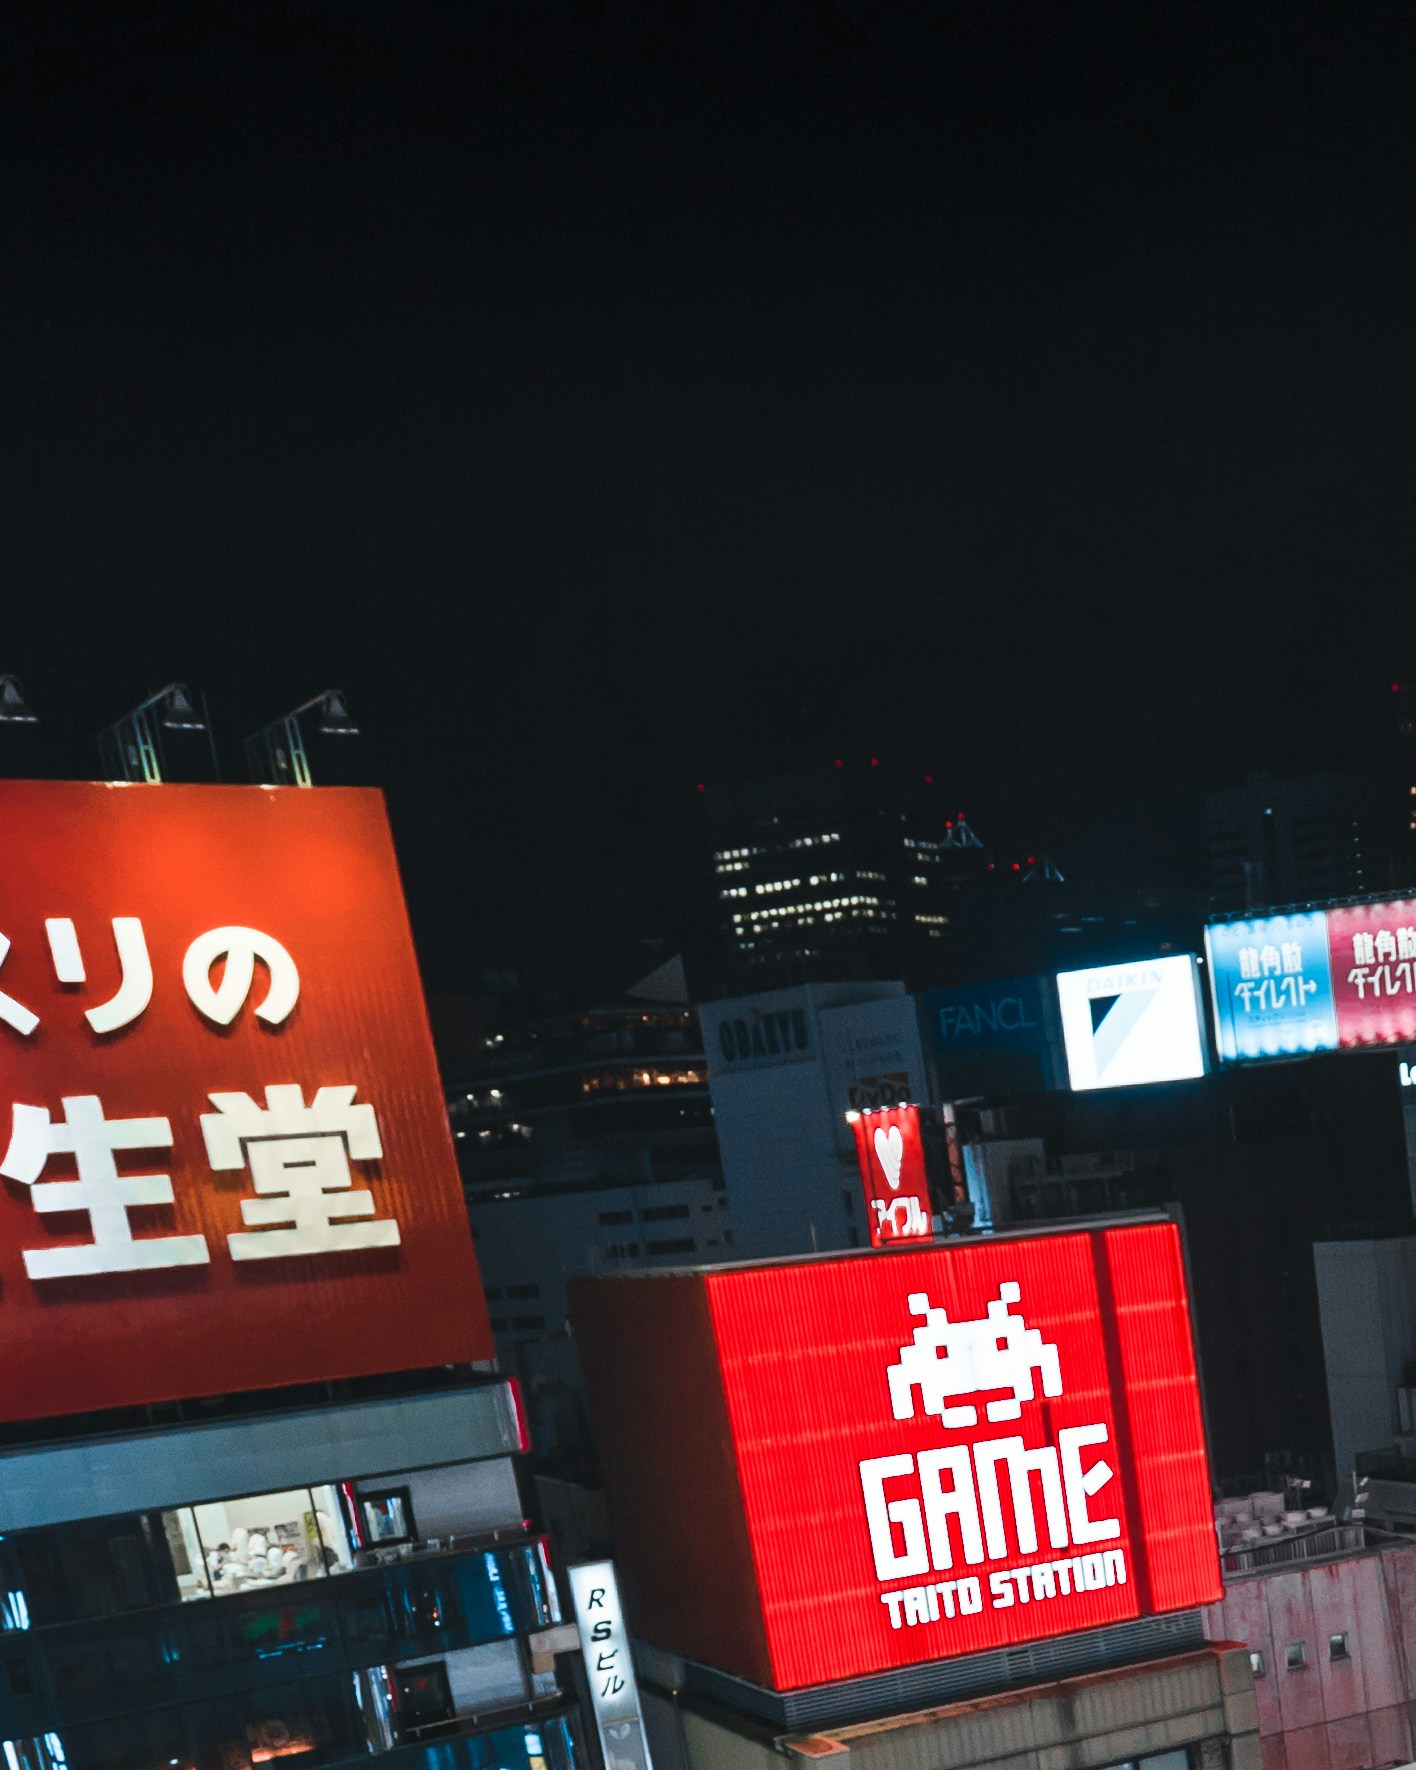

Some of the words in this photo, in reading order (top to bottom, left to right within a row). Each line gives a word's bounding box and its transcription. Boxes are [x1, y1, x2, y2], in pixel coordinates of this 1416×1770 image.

[1086, 969, 1164, 994] DAIKIN
[719, 1007, 809, 1063] ODAKYU
[939, 999, 1037, 1038] FANCL
[0, 1083, 401, 1281] 生堂
[859, 1423, 1121, 1582] GAME
[880, 1576, 982, 1630] TAITO
[990, 1548, 1128, 1610] STATION
